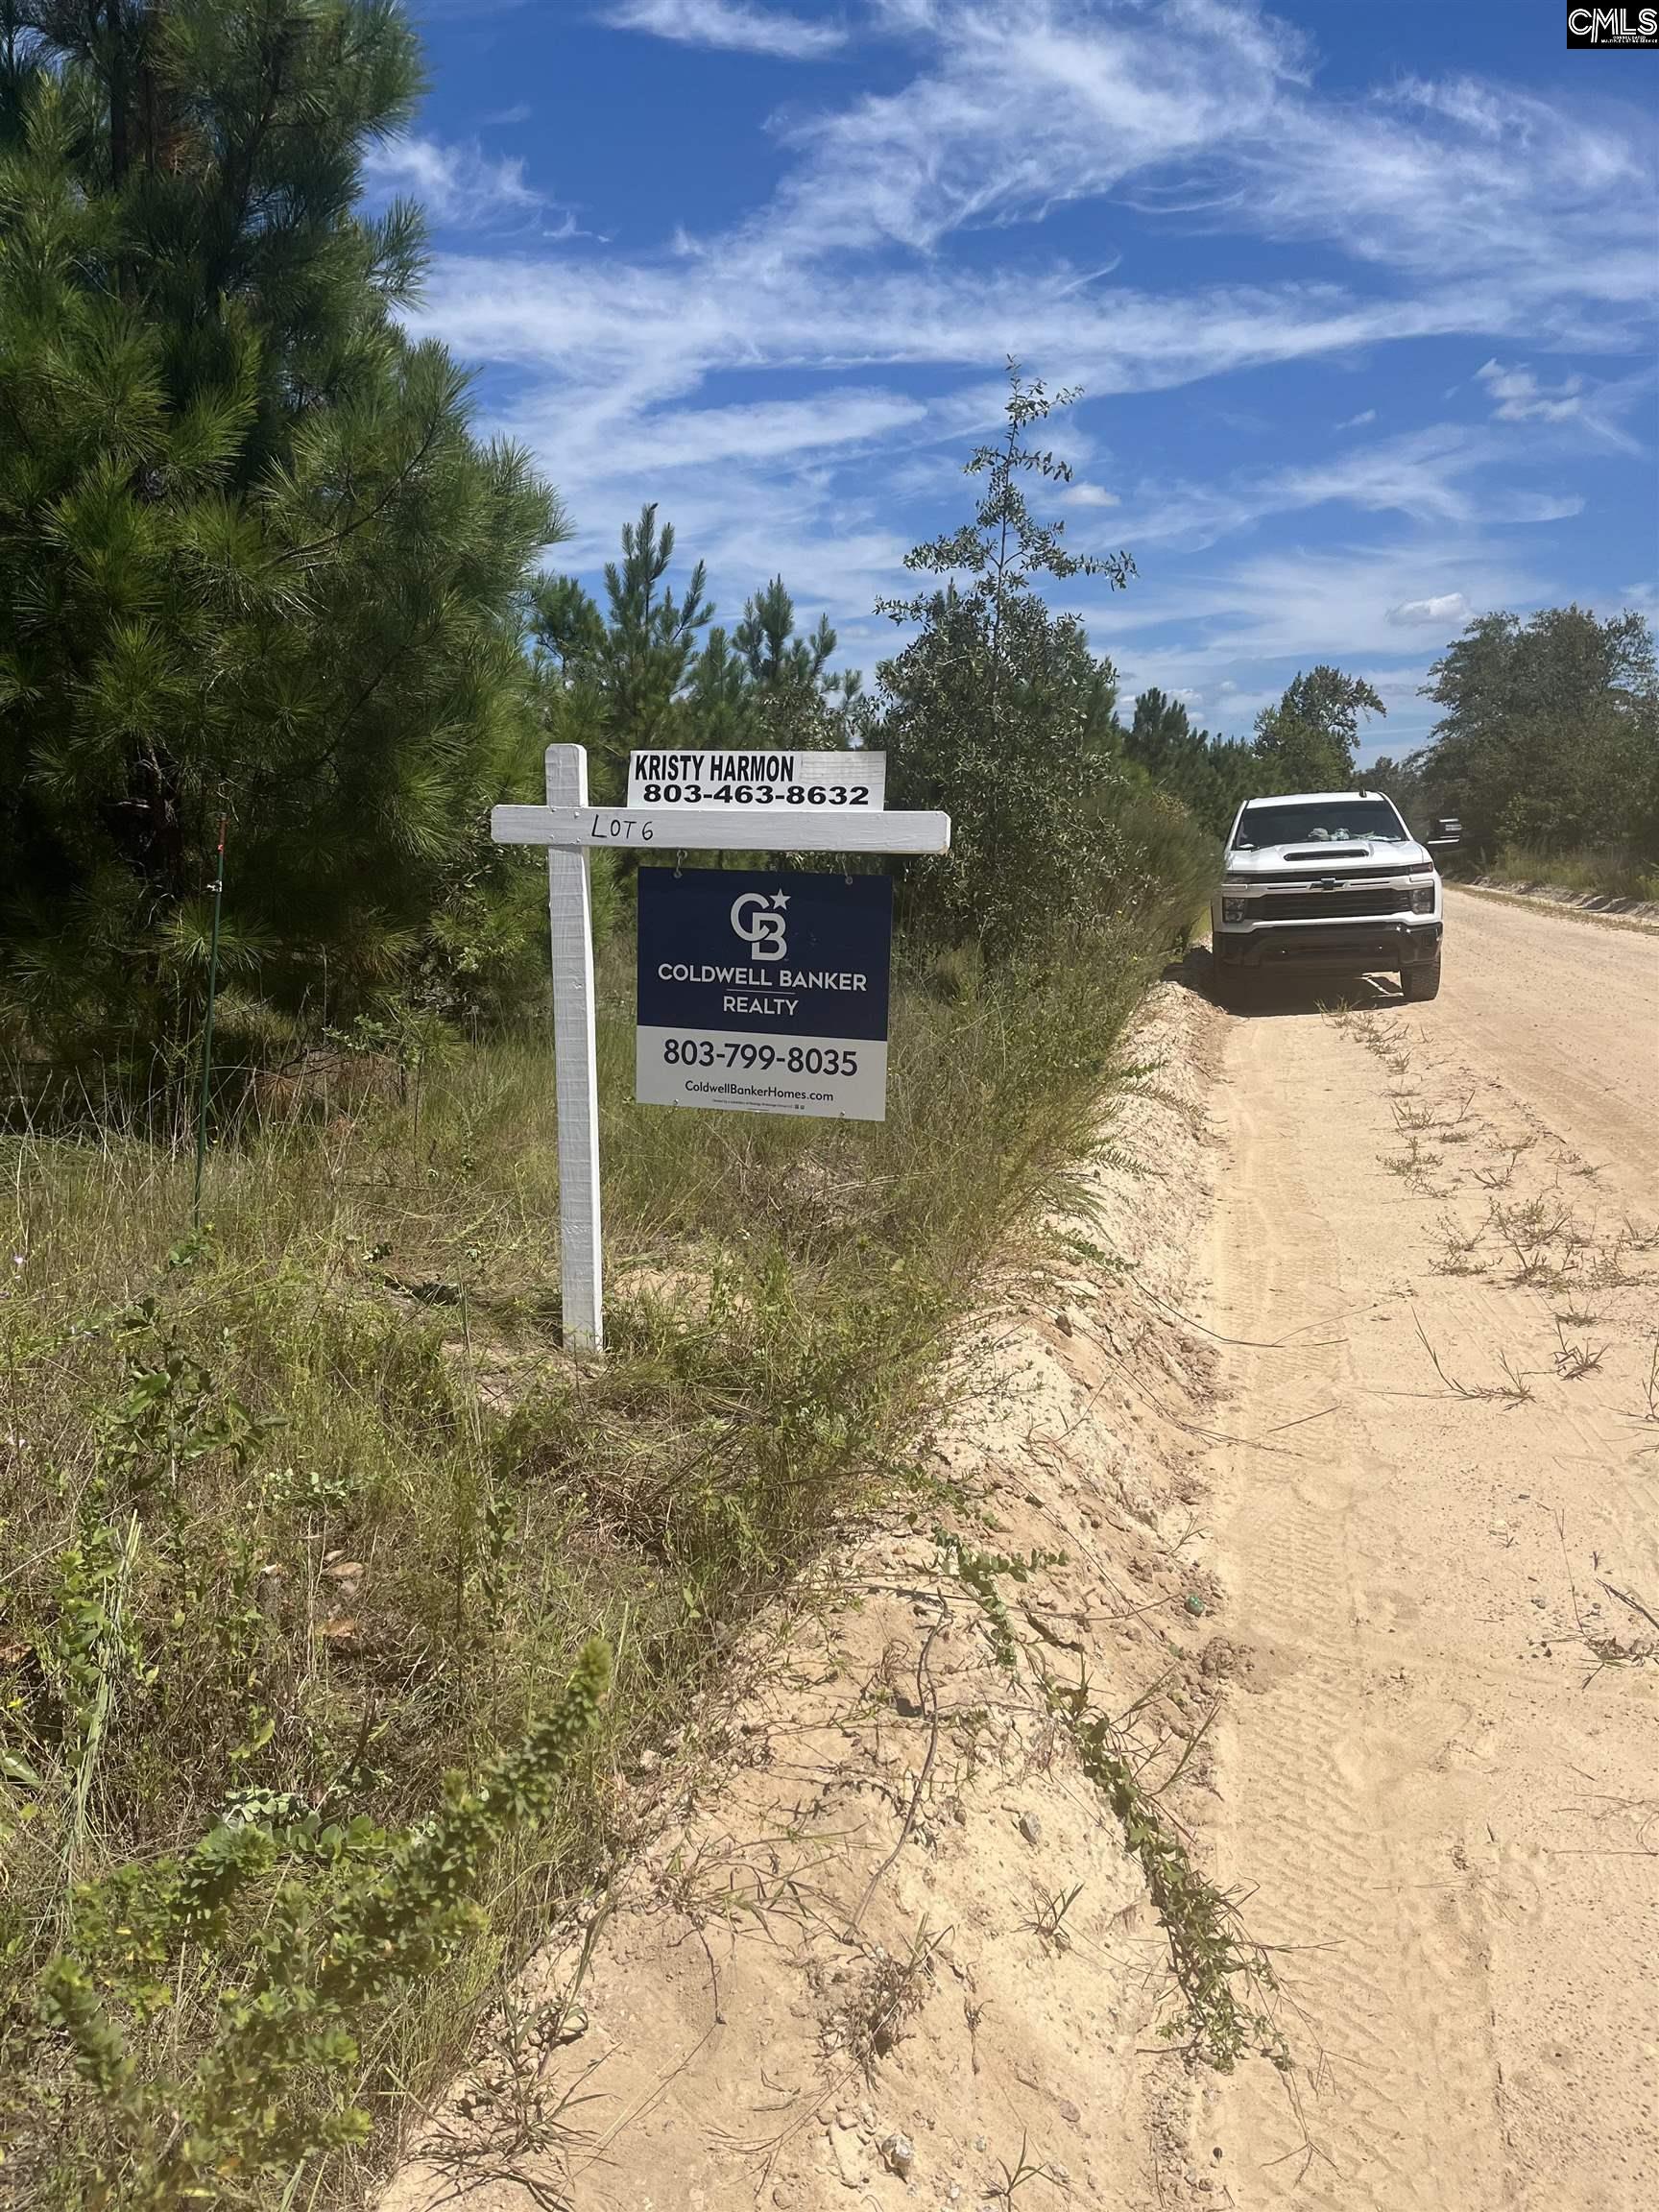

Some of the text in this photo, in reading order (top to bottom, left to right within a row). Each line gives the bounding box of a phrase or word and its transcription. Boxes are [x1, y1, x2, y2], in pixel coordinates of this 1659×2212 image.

[635, 755, 795, 782] KRISTY HARMON
[643, 783, 870, 805] 803-463-8632
[591, 813, 654, 841] LOT 6
[730, 892, 788, 961] CB
[658, 963, 868, 992] COLDWELL BANKER
[723, 996, 800, 1016] REALTY
[662, 1038, 858, 1077] 803-799-8035
[685, 1080, 834, 1102] ColdwellBankerHomes.com
